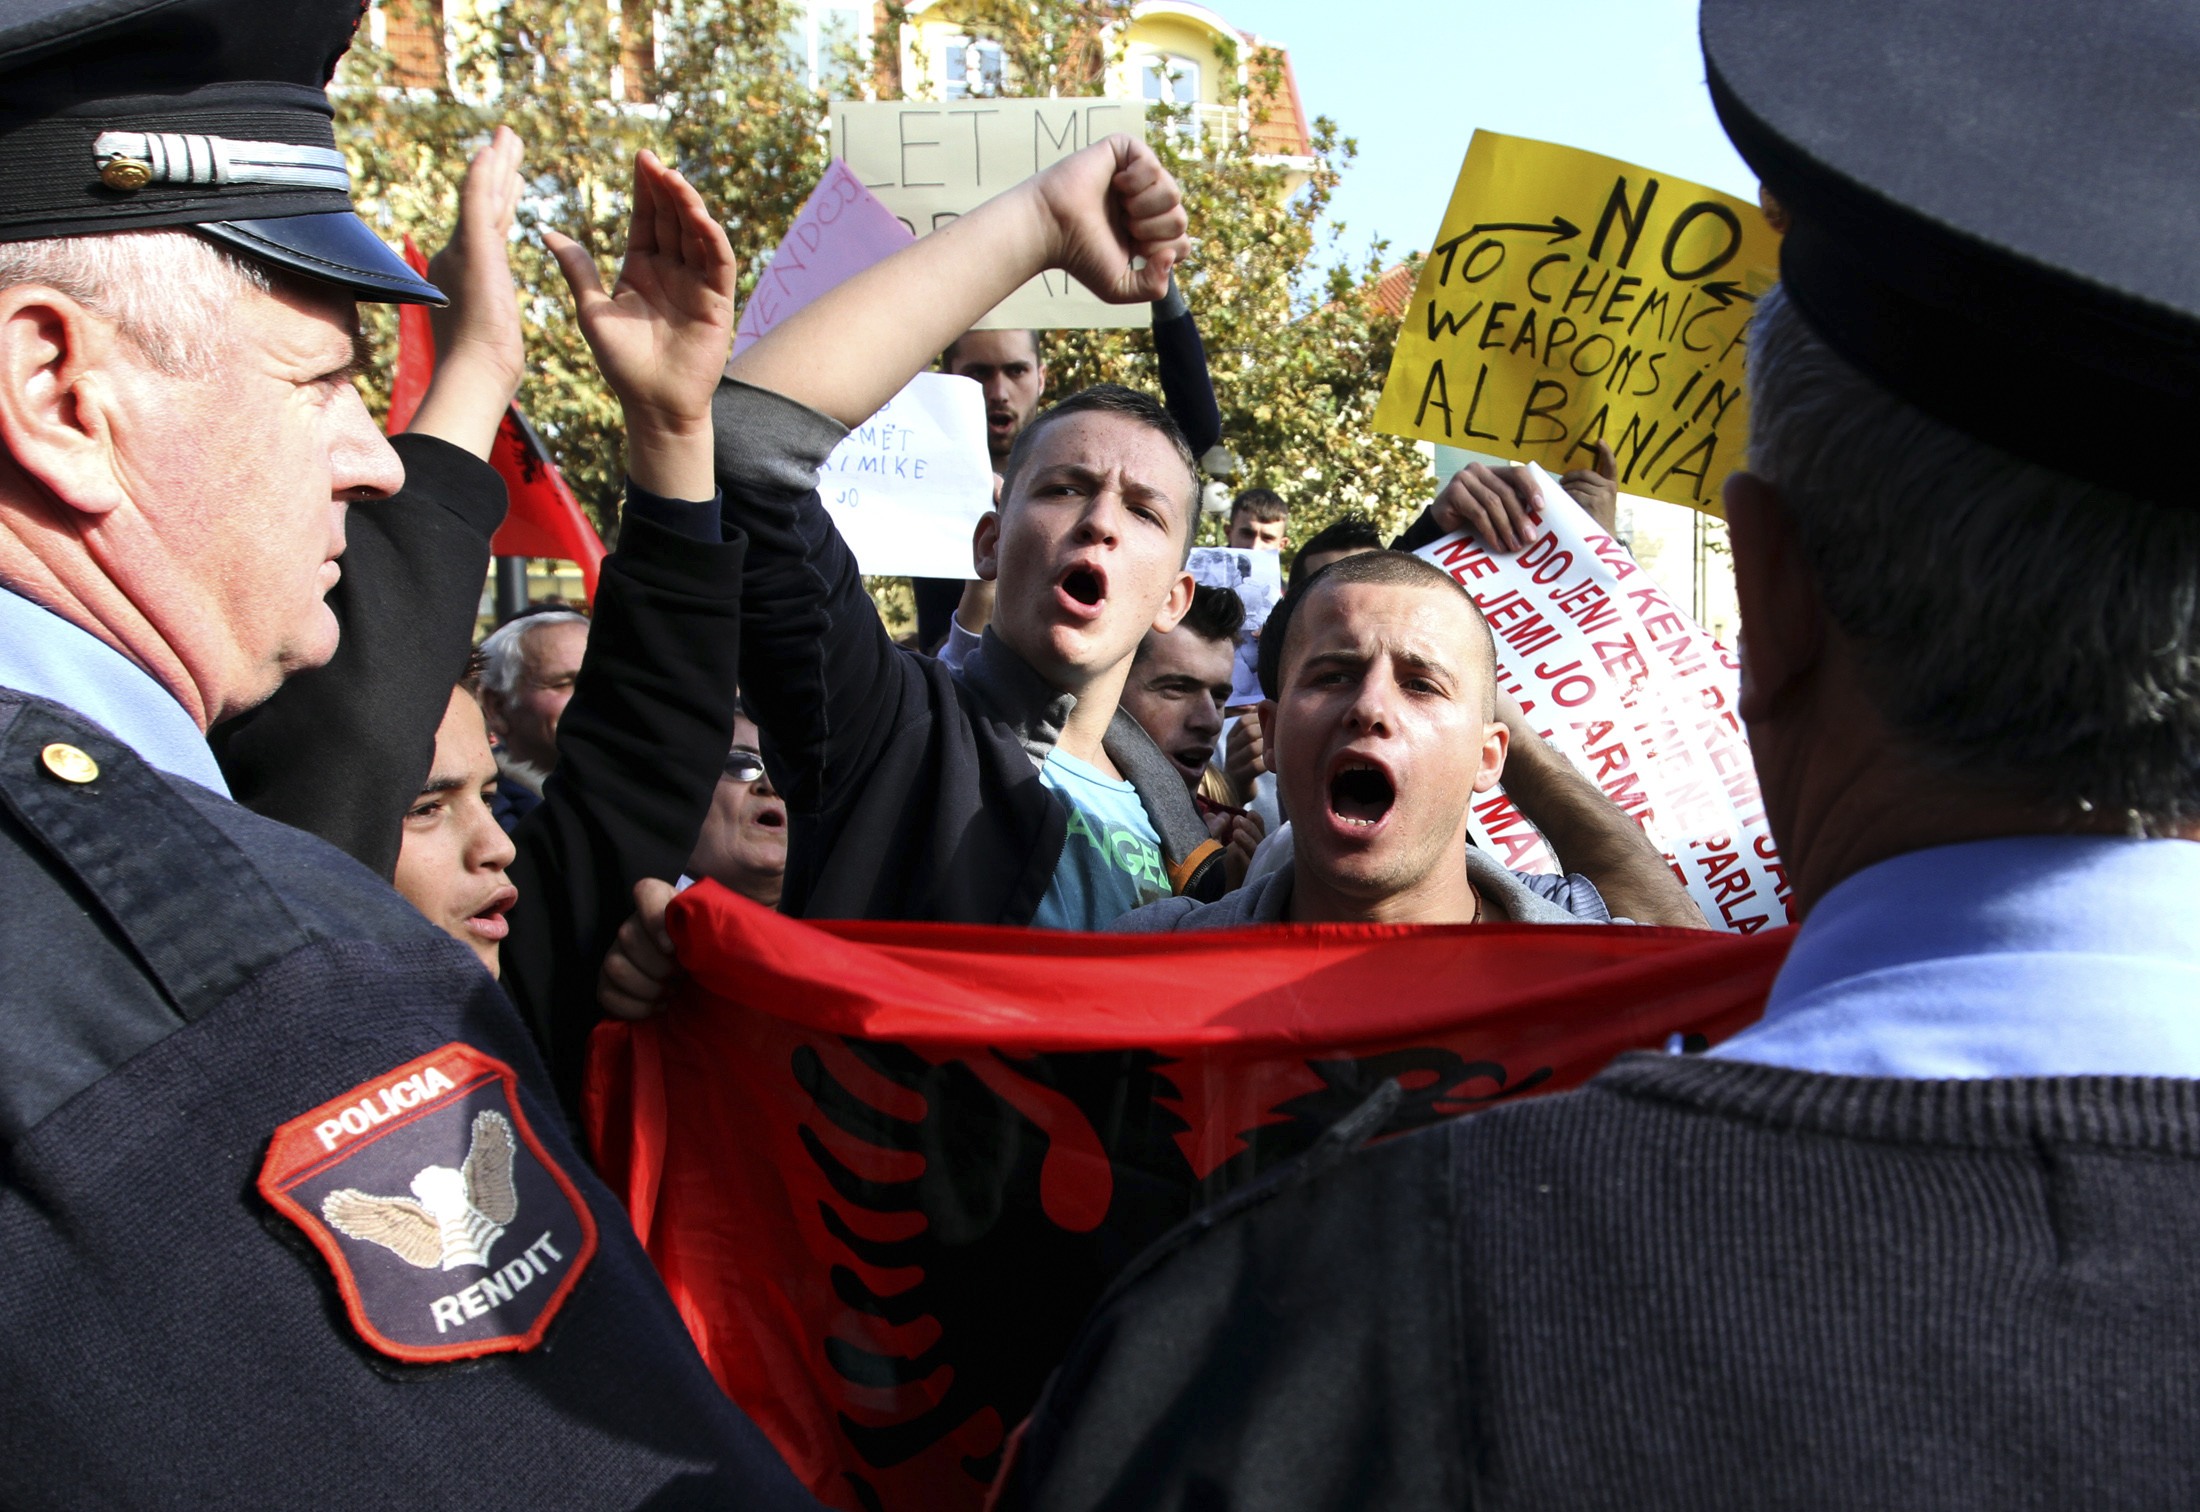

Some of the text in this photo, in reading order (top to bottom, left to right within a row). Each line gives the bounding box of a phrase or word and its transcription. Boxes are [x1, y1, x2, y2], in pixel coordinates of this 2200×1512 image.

[842, 109, 1000, 187] LET
[1435, 227, 1506, 286] TO
[1588, 174, 1743, 281] NO
[1427, 299, 1742, 429] WEAPONS IN
[835, 488, 859, 508] JO
[1434, 536, 1501, 588] NE
[1475, 589, 1563, 657] JEMI
[1534, 660, 1597, 709] JO
[1516, 531, 1574, 585] DO
[1549, 578, 1623, 635] JENI
[1584, 535, 1638, 582] NA
[1626, 587, 1708, 678] KENI
[312, 1066, 456, 1151] POLICIA
[429, 1230, 563, 1334] RENDIT
